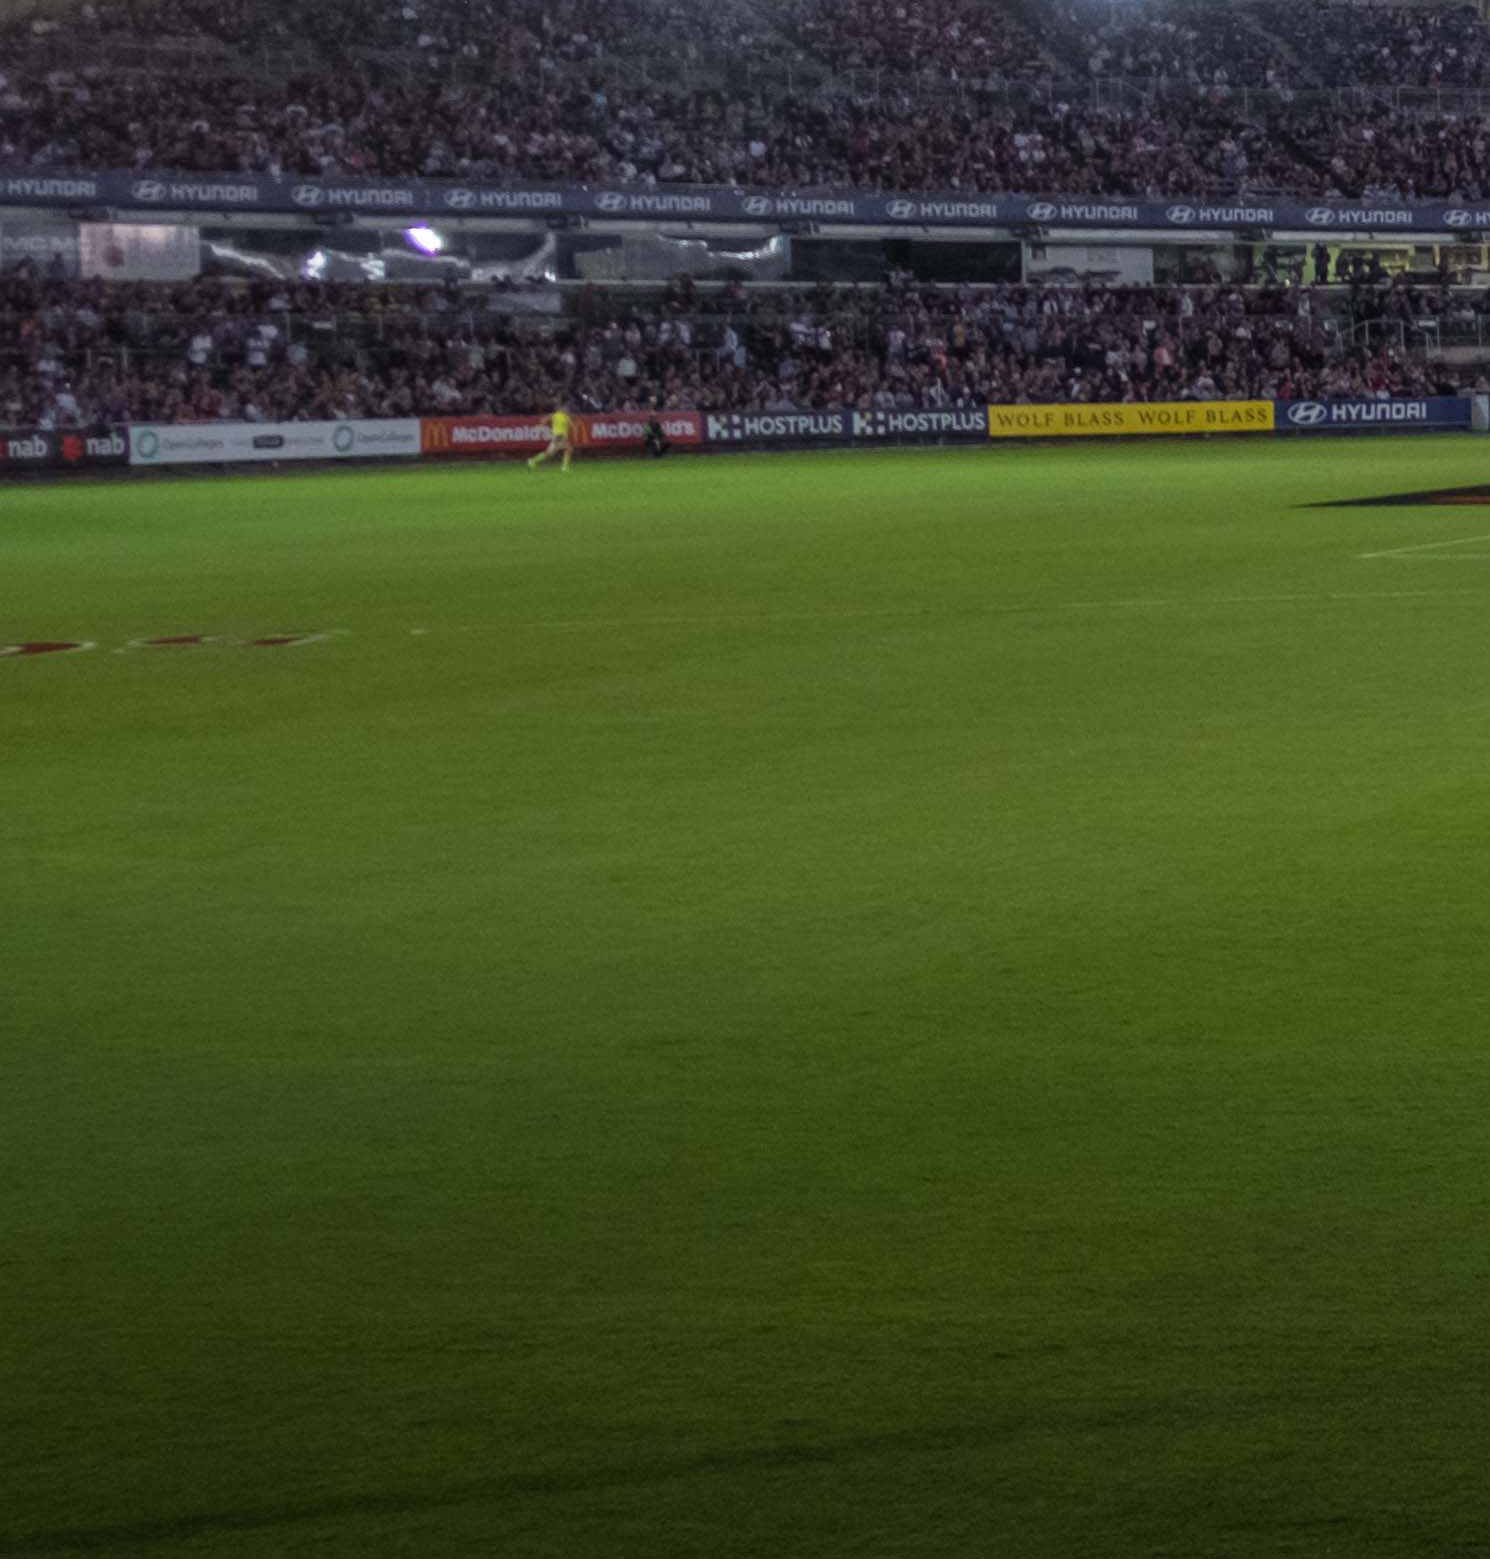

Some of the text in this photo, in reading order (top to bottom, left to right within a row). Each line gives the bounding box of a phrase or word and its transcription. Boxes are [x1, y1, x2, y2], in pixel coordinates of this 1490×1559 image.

[7, 180, 96, 197] HYUNDAI
[171, 185, 257, 202] HYUNDAI
[328, 190, 413, 206] HYUNDAI
[481, 192, 561, 209] HYUNDAI
[630, 194, 711, 212] HYUNDAI
[776, 197, 855, 215] HYUNDAI
[921, 201, 997, 218] HYUNDAI
[1061, 205, 1137, 221] HYUNDAI
[1199, 208, 1273, 224] HYUNDAI
[1339, 209, 1412, 224] HYUNDAI
[997, 408, 1267, 428] WOLF BLASS WOLF BLASS
[1332, 402, 1426, 421] HYUNDAI
[745, 415, 843, 436] HOSTPLUS
[888, 412, 985, 433] HOSTPLUS
[8, 437, 47, 459] nab
[87, 435, 125, 456] nab
